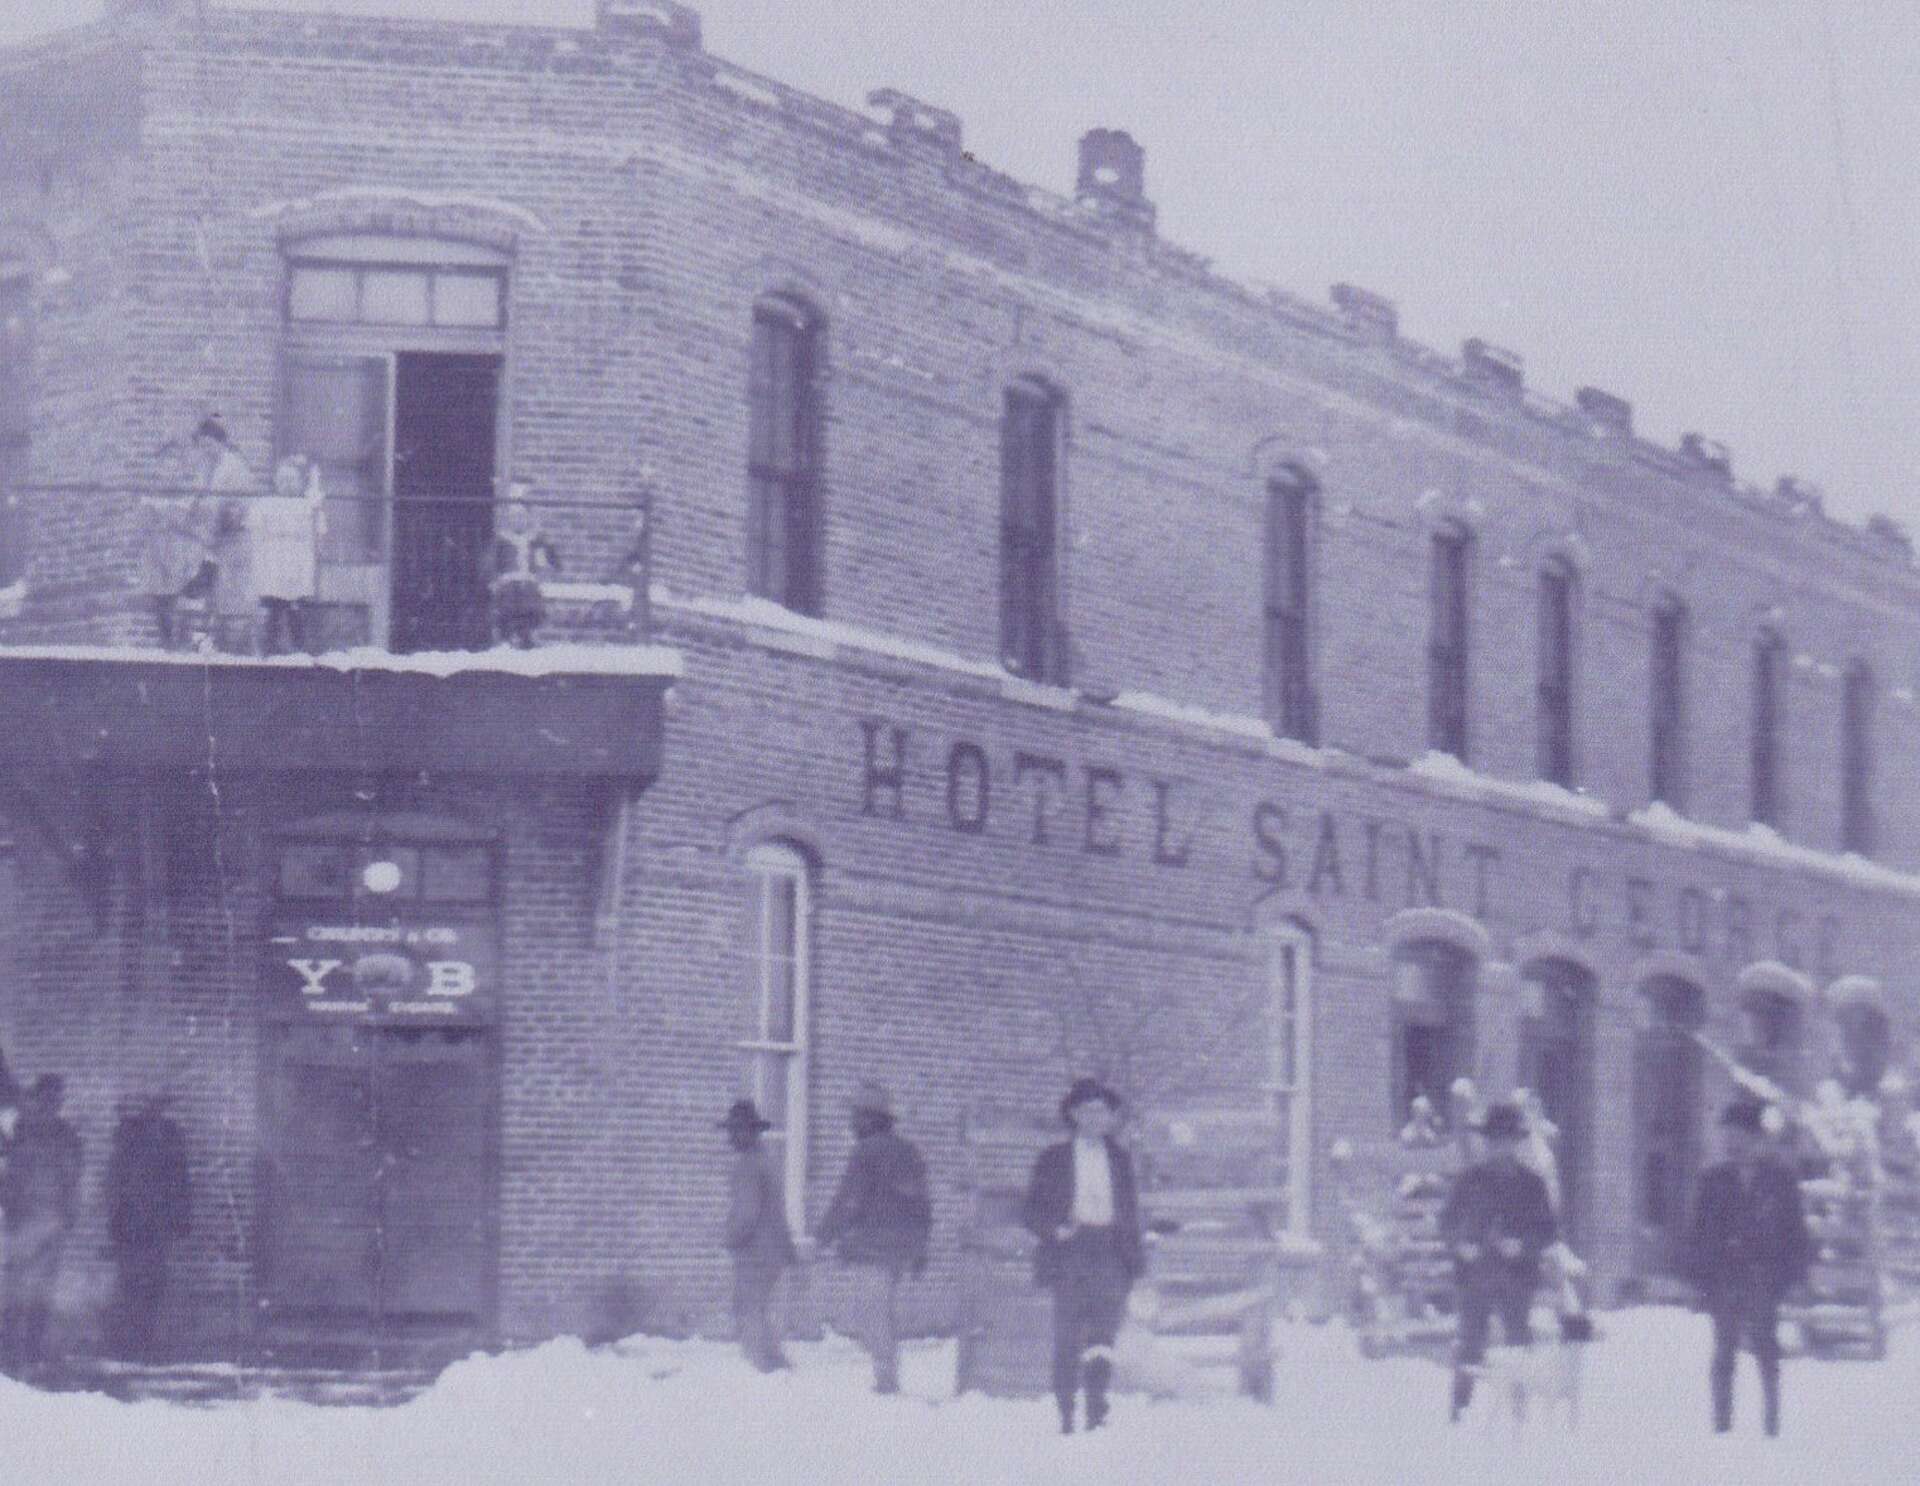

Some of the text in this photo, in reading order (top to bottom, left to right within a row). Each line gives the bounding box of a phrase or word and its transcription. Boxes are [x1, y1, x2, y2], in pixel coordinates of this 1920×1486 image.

[860, 714, 1193, 869] HOTEL
[1252, 802, 1501, 919] SAINT
[287, 959, 477, 997] Y B
